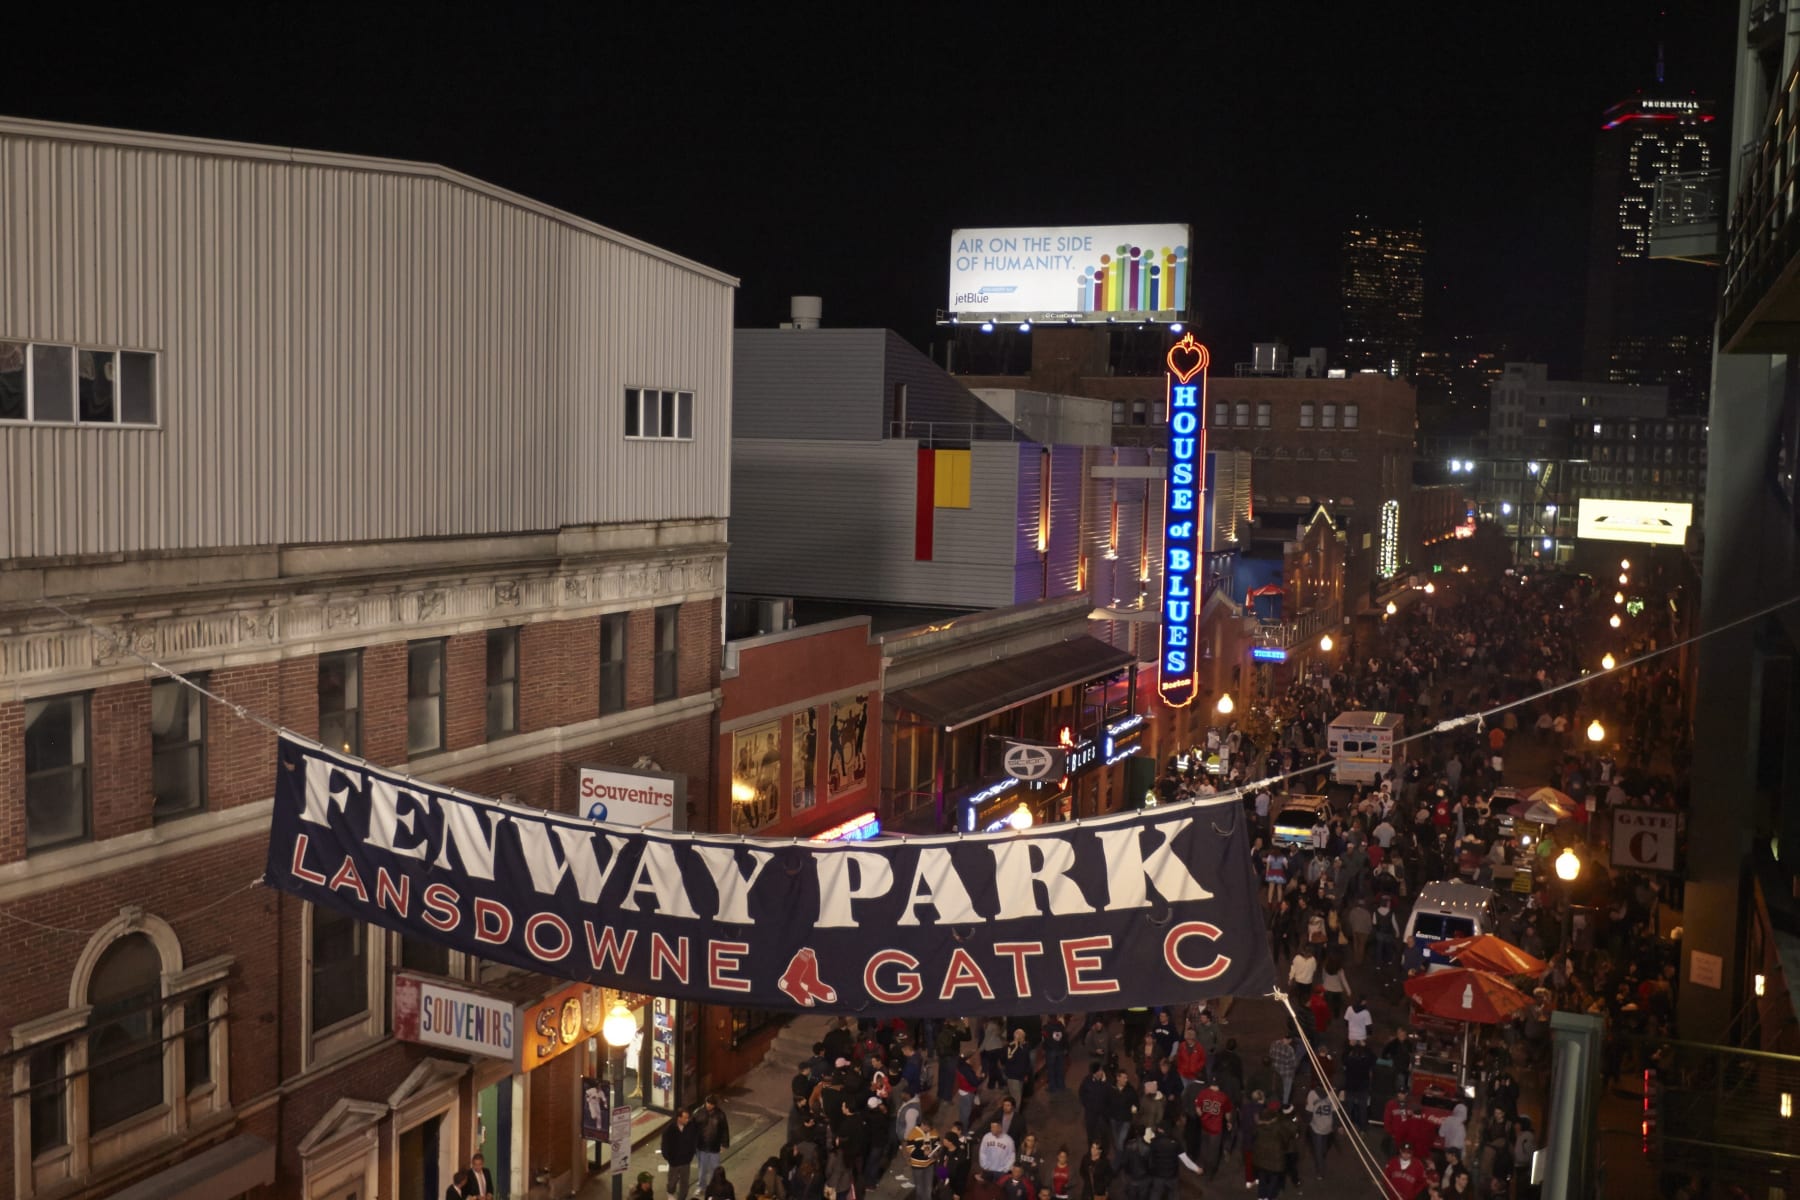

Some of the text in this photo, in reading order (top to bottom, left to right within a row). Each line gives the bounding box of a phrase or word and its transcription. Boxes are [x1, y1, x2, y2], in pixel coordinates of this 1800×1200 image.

[1642, 101, 1699, 109] PRUDENTIAL
[958, 236, 1092, 254] AIR ON THE SIDE
[956, 255, 1076, 272] OF HUMANITY.
[954, 293, 989, 305] jetBlue
[1167, 386, 1197, 672] HOUSE of BLUES
[1162, 679, 1192, 691] Boston
[1072, 746, 1096, 772] BLUES
[581, 778, 673, 807] Souvenirs
[1618, 814, 1674, 829] GATE
[299, 754, 1215, 929] FENWAY PARK
[1629, 831, 1658, 864] C
[291, 833, 1232, 1003] LANSDOWNE GATE C
[423, 995, 512, 1049] SOUVENIRS
[1316, 1105, 1331, 1116] 49
